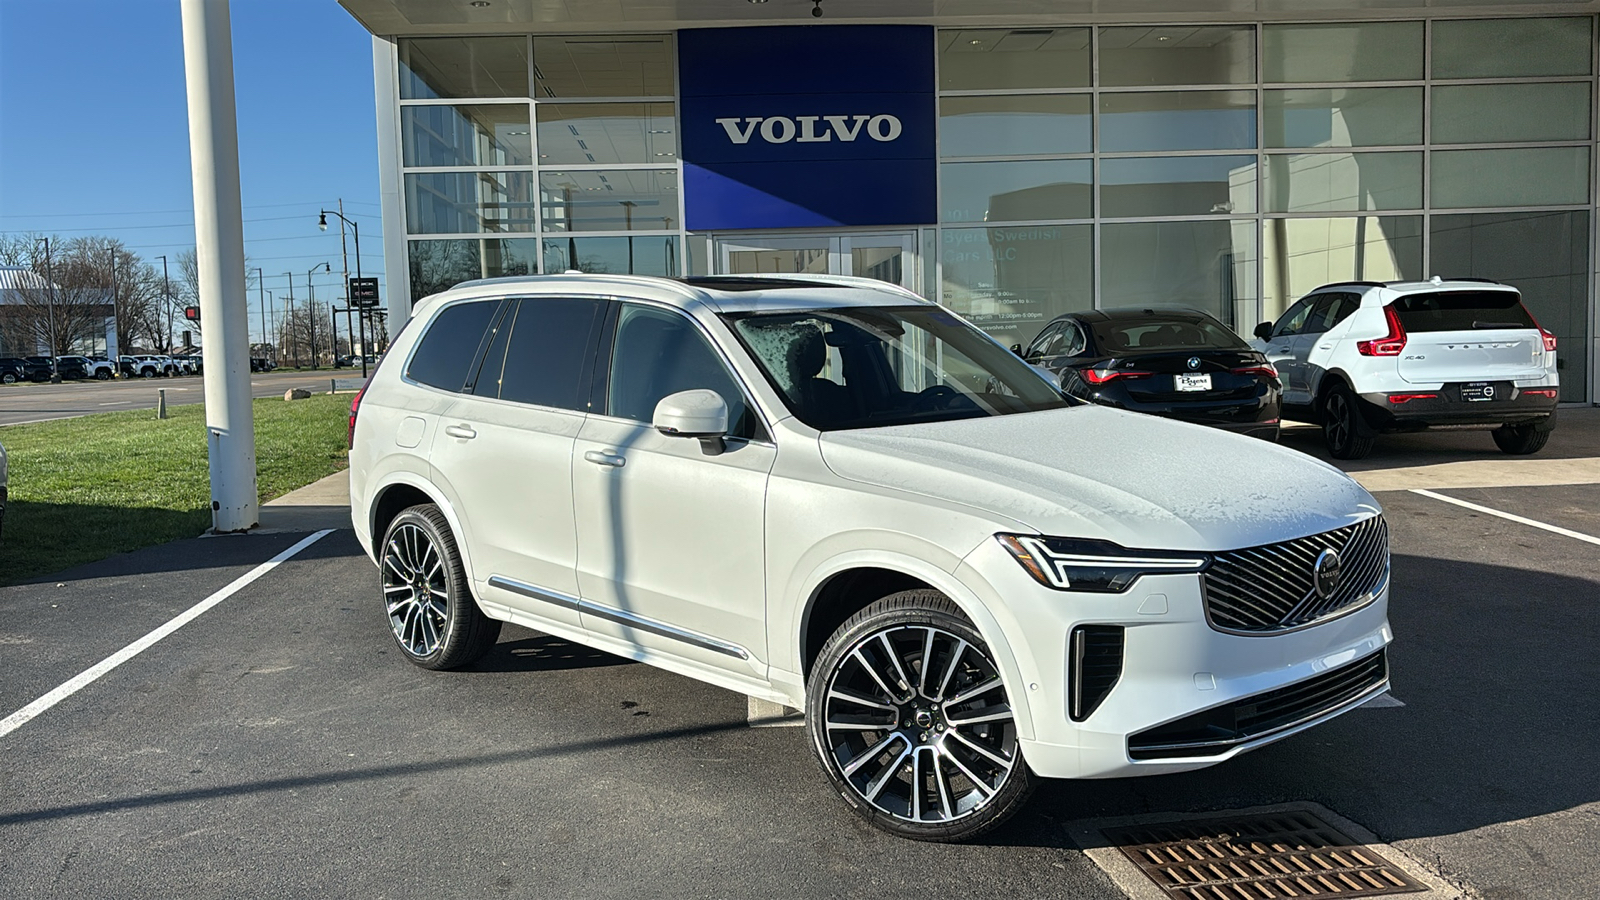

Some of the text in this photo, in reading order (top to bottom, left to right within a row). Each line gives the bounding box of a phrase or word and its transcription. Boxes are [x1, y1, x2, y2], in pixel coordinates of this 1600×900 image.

[716, 114, 902, 144] VOLVO
[944, 228, 1062, 246] Byers Swedish
[944, 247, 1016, 262] Cars LLC
[1178, 377, 1207, 386] Byers
[1320, 570, 1340, 578] VOLVO
